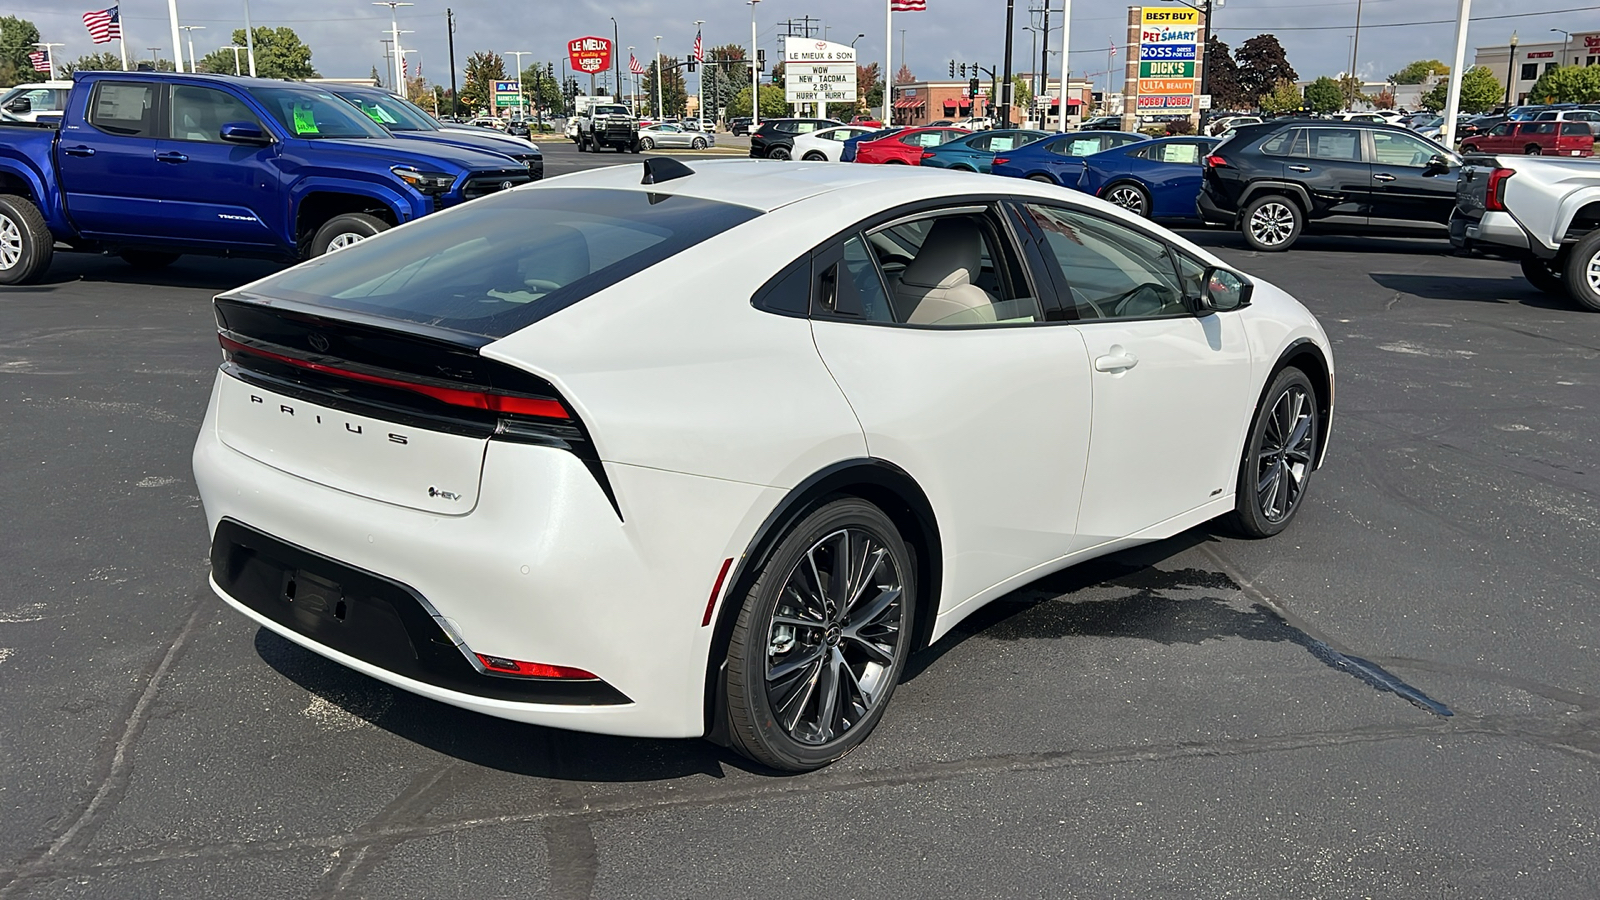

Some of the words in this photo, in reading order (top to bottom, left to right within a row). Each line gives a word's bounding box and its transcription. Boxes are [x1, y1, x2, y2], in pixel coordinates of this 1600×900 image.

[571, 42, 581, 51] LE
[583, 39, 607, 51] MIEUX
[1141, 47, 1172, 58] ROSS
[812, 66, 829, 74] WOW
[1150, 62, 1185, 74] DICK'S
[819, 75, 846, 83] TACOMA
[1143, 81, 1165, 89] ULTA
[796, 92, 818, 100] HURRY
[1138, 96, 1165, 107] HOBBY
[1167, 96, 1191, 106] LOBBY
[250, 394, 408, 445] PRIUS
